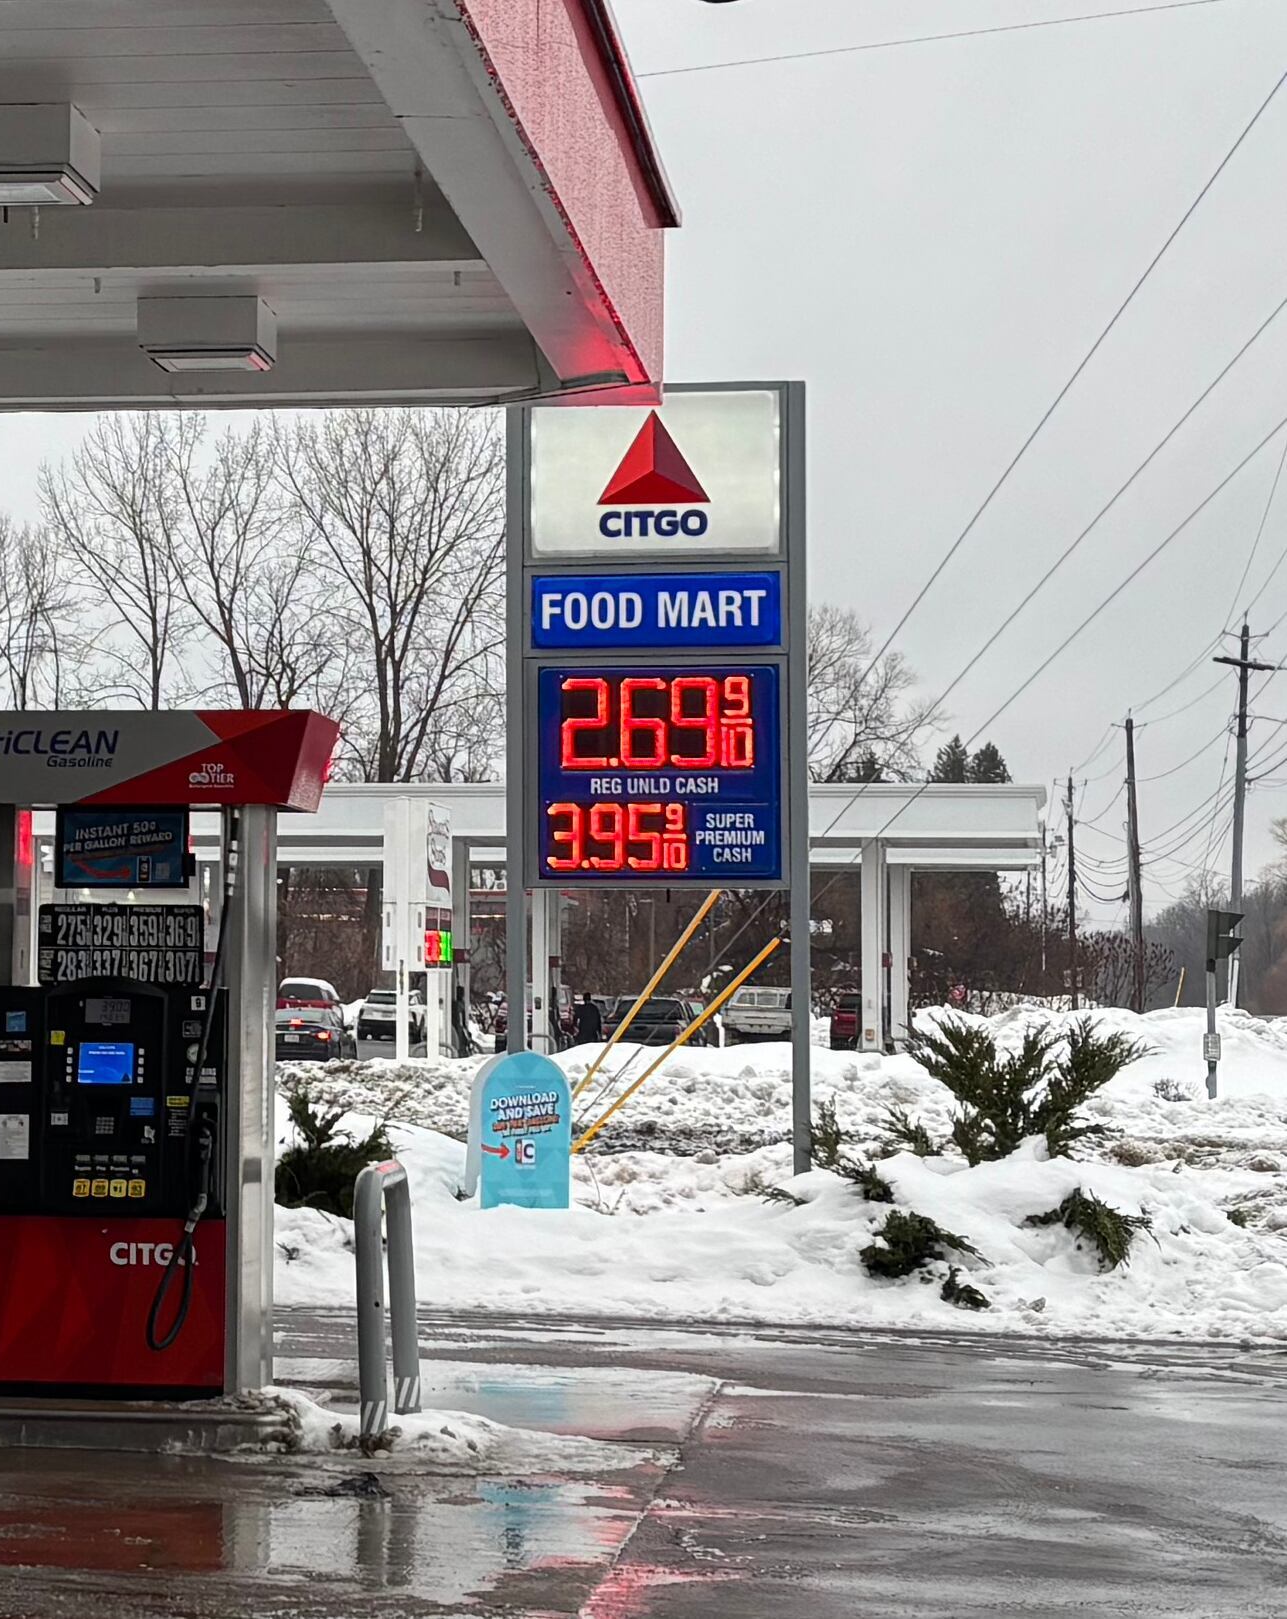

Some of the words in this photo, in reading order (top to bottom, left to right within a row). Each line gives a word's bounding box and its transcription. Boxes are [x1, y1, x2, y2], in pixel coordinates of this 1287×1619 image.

[599, 509, 708, 538] CITGO
[541, 592, 643, 629] FOOD
[657, 589, 766, 628] MART
[561, 677, 717, 767] 2.69
[46, 755, 114, 768] Gasoline
[201, 763, 224, 773] TOP
[210, 772, 235, 783] TIER
[590, 778, 622, 794] REG
[627, 778, 670, 794] UNLD
[676, 777, 719, 793] CASH
[705, 813, 754, 828] SUPER
[75, 823, 129, 840] INSTANT
[547, 803, 662, 869] 3.95
[695, 830, 765, 845] PREMIUM
[63, 842, 82, 852] PER
[84, 837, 125, 850] GALLON
[130, 832, 172, 845] REWARD
[713, 848, 752, 862] CASH
[490, 1091, 558, 1109] DOWNLOAD
[498, 1108, 523, 1121] AND
[526, 1103, 554, 1118] SAVE
